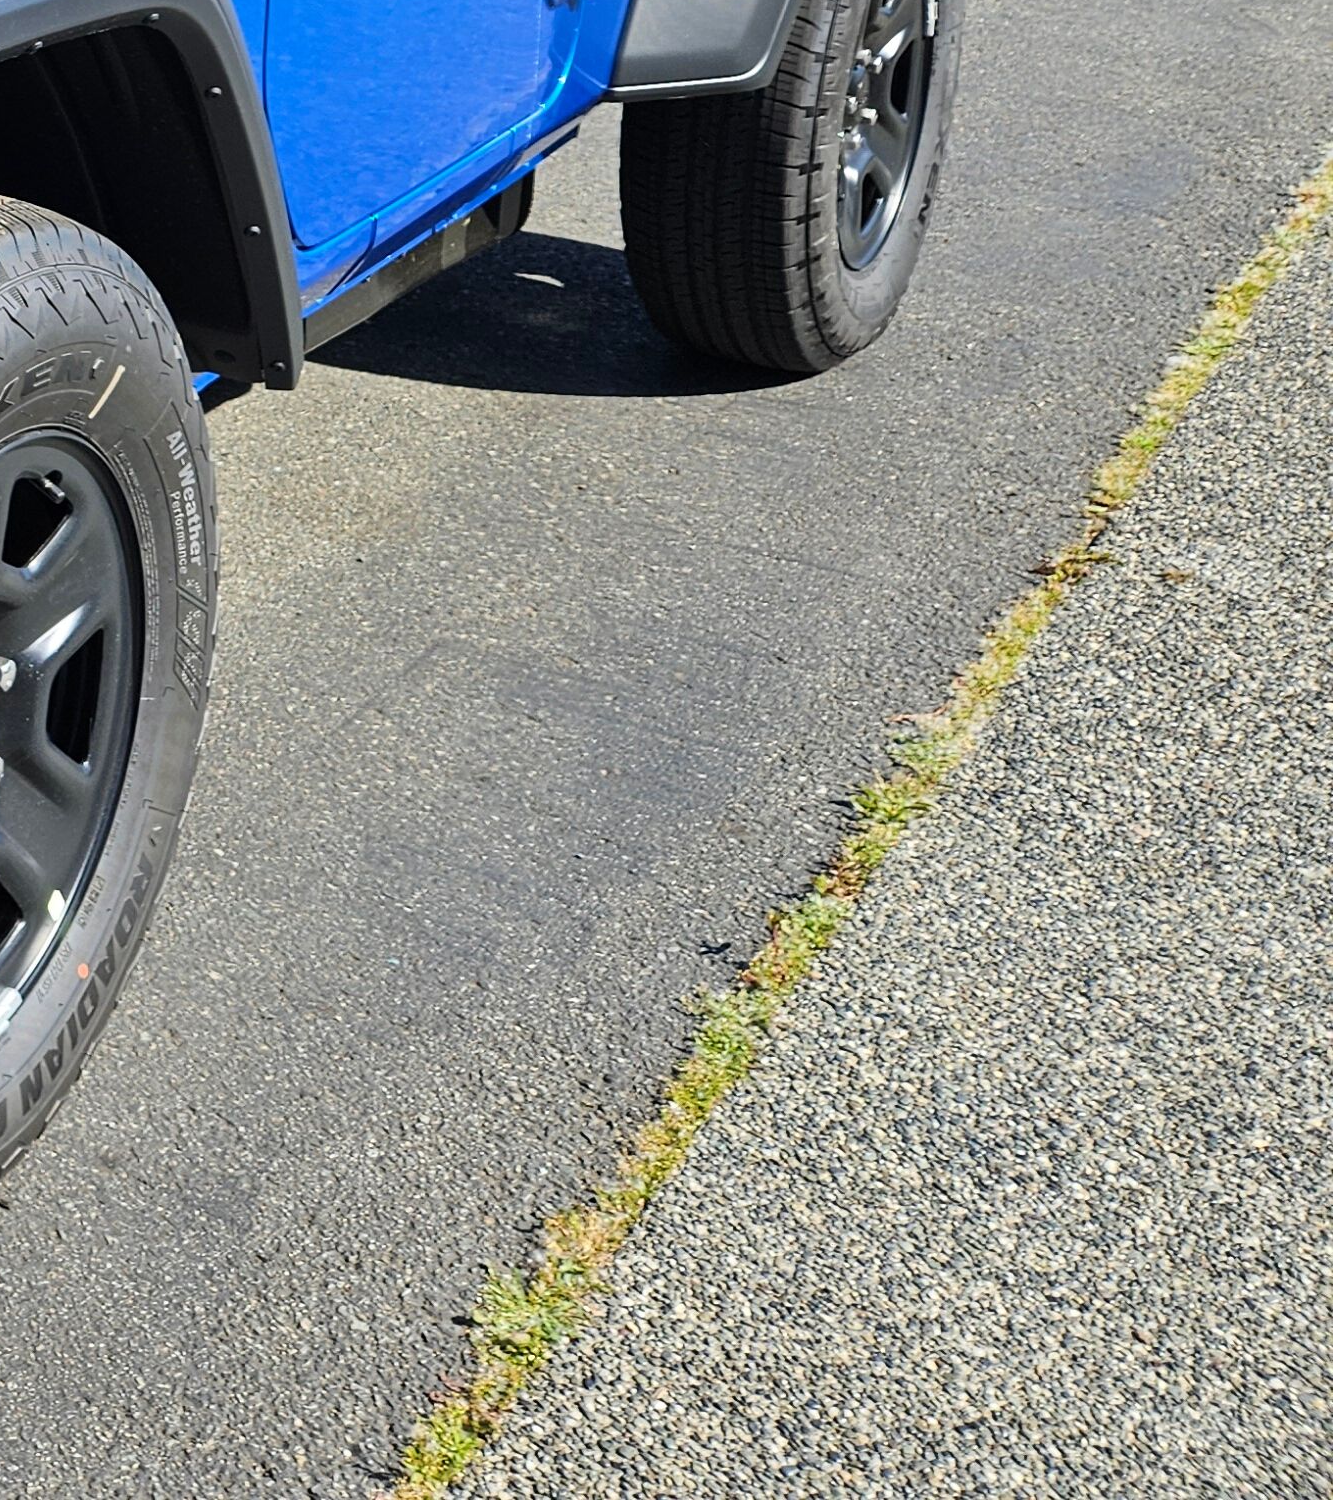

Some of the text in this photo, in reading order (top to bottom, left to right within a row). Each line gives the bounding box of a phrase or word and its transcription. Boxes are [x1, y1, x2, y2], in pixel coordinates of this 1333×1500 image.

[165, 429, 201, 567] All-Weather
[170, 490, 189, 575] Performance
[19, 851, 154, 1115] ROADIAN
